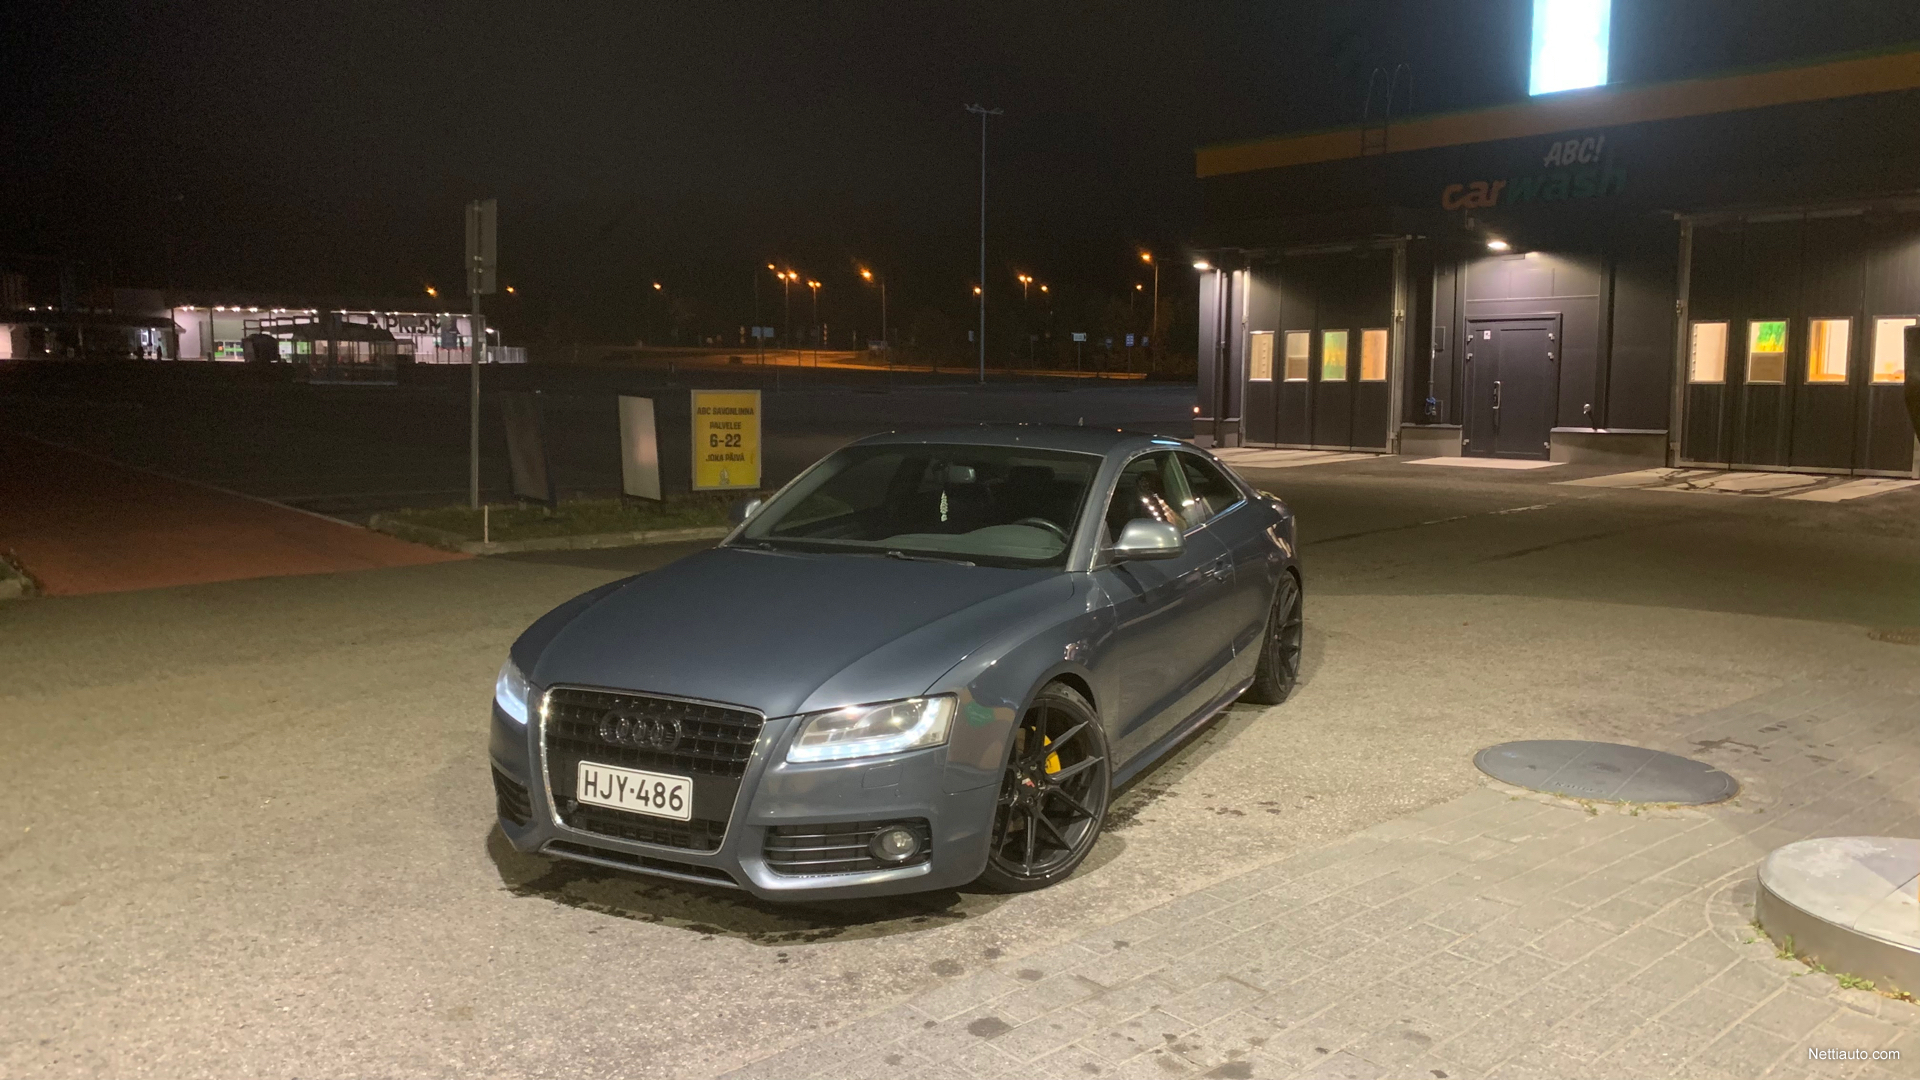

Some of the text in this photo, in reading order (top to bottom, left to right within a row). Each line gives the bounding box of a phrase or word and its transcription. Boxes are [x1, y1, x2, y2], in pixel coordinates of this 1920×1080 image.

[1543, 133, 1606, 168] ABC!
[697, 407, 754, 415] ABC SAVONLINNA
[709, 421, 742, 430] PALVELEE
[709, 433, 742, 448] 6-22
[705, 452, 745, 462] JOKA PÄIVÄ
